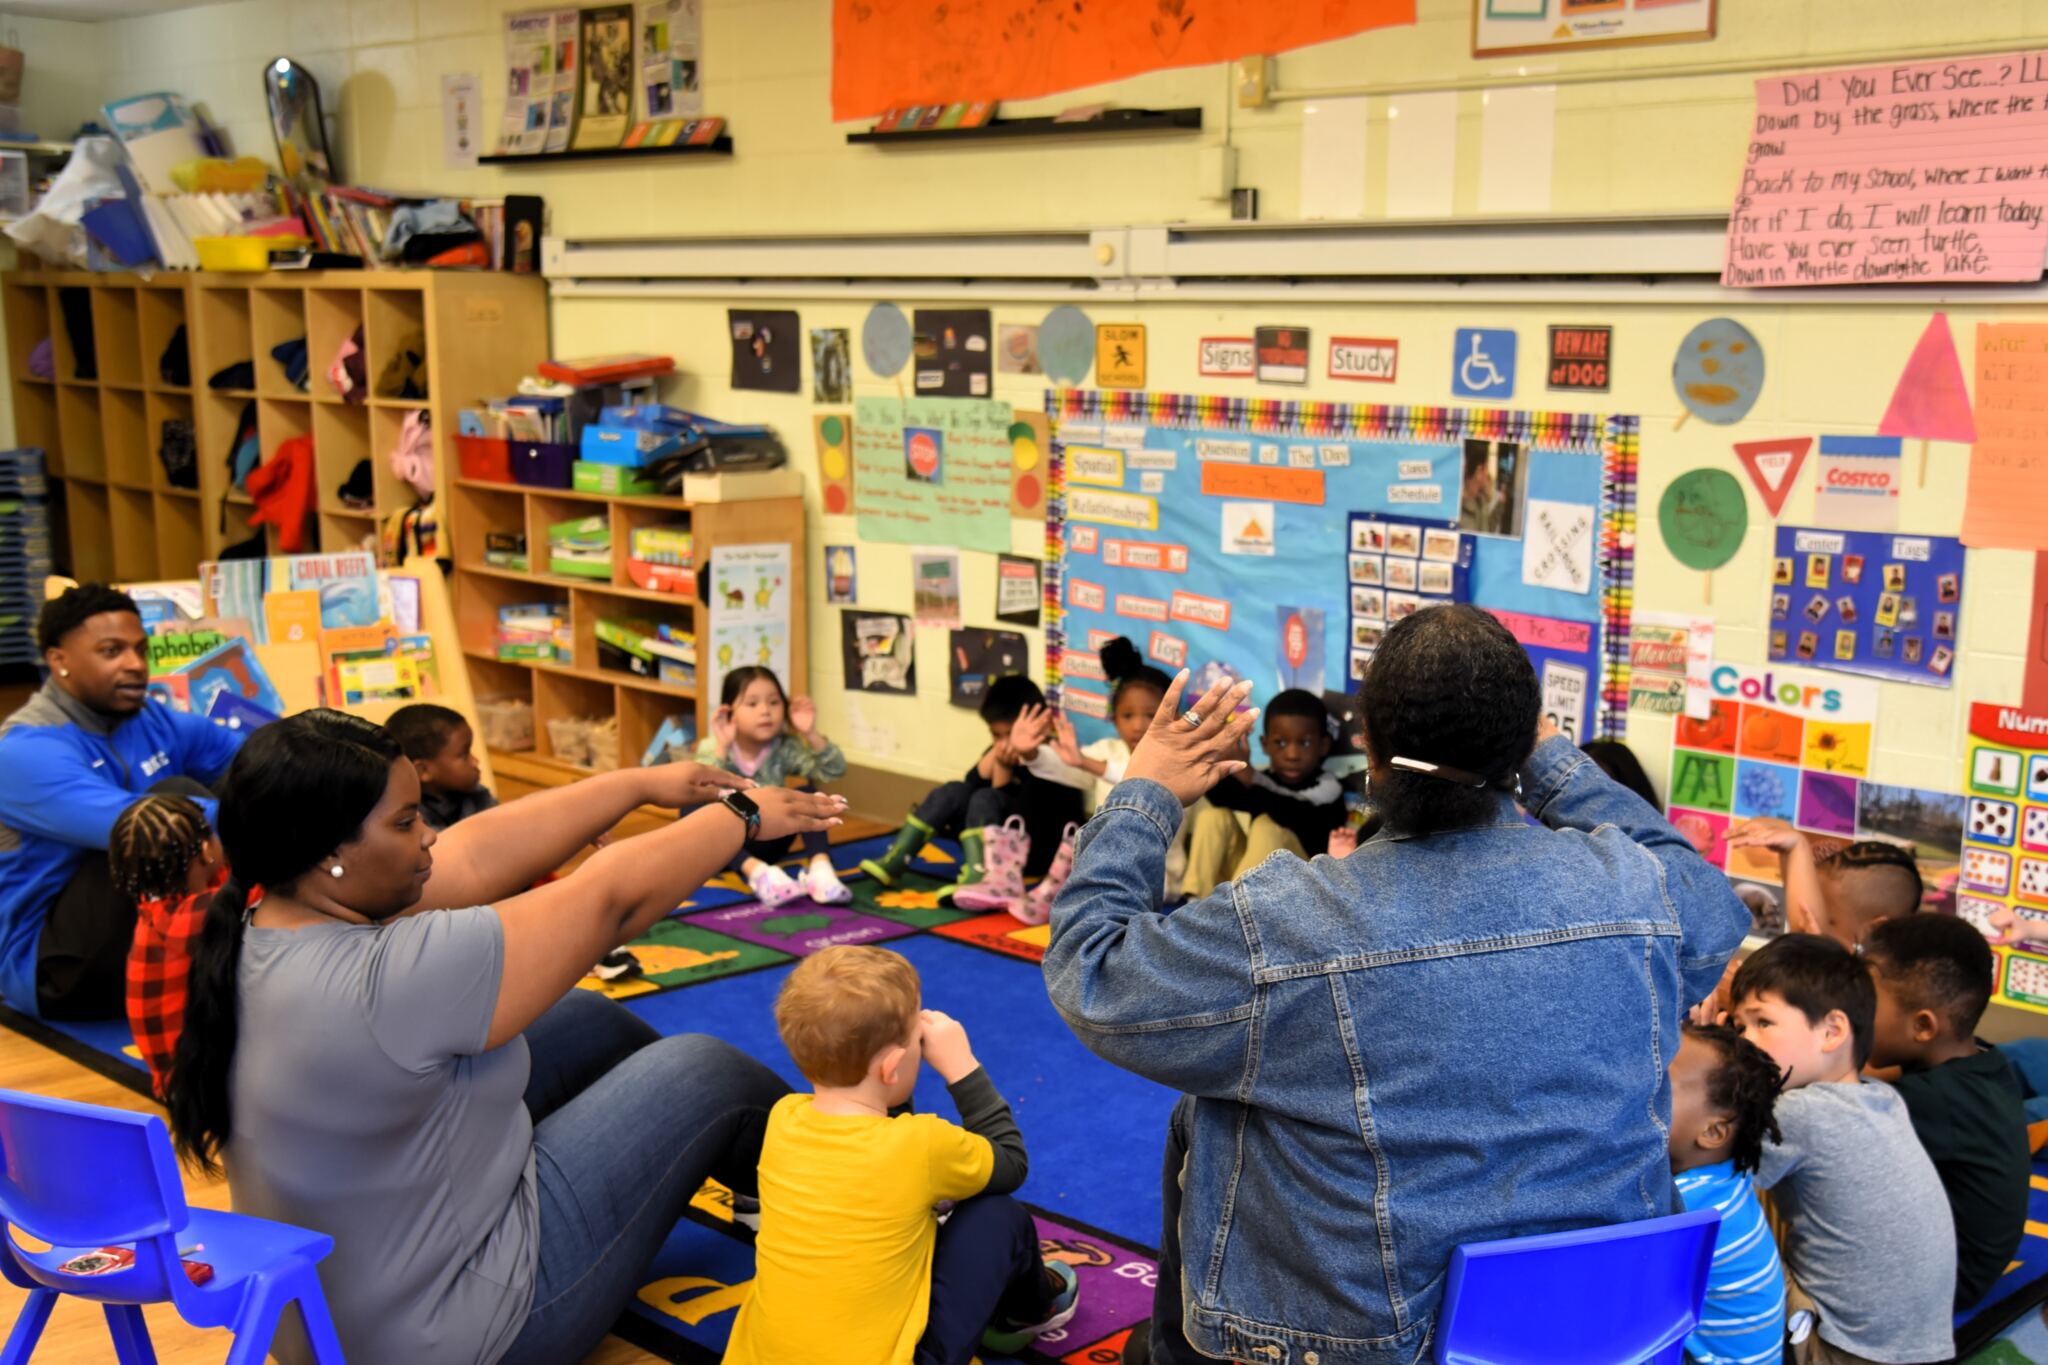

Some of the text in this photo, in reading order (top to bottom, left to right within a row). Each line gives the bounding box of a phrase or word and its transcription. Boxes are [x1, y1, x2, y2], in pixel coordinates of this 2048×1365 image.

[1782, 79, 1820, 106] Did
[1841, 76, 1876, 105] You
[1891, 67, 1937, 94] Ever
[1813, 111, 1841, 135] by
[1852, 106, 1882, 126] the
[2004, 93, 2034, 115] the
[1742, 168, 1795, 195] Back
[1802, 170, 1825, 193] to
[1974, 167, 1994, 184] I
[1767, 208, 1789, 232] if
[1793, 208, 1819, 233] I
[1860, 203, 1894, 230] I
[1896, 204, 1931, 227] will
[1936, 199, 1987, 225] learn
[1729, 235, 1776, 263] Have
[1818, 239, 1858, 260] ever
[1725, 261, 1765, 287] Down
[1769, 265, 1786, 282] in
[1554, 330, 1608, 356] BEWARE
[1203, 343, 1255, 372] Signs
[1334, 346, 1393, 378] Study
[1567, 362, 1607, 386] DOG
[1073, 453, 1118, 477] Spatial
[1290, 449, 1314, 466] The
[1322, 447, 1348, 467] Day
[1073, 496, 1151, 525] Relationships
[1796, 534, 1930, 561] Center Tags
[152, 633, 222, 668] phabet
[1156, 637, 1181, 664] Top
[1633, 643, 1686, 668] Mexico
[1546, 672, 1581, 695] SPEED
[1709, 665, 1842, 712] Colors
[1546, 693, 1577, 713] LIMIT
